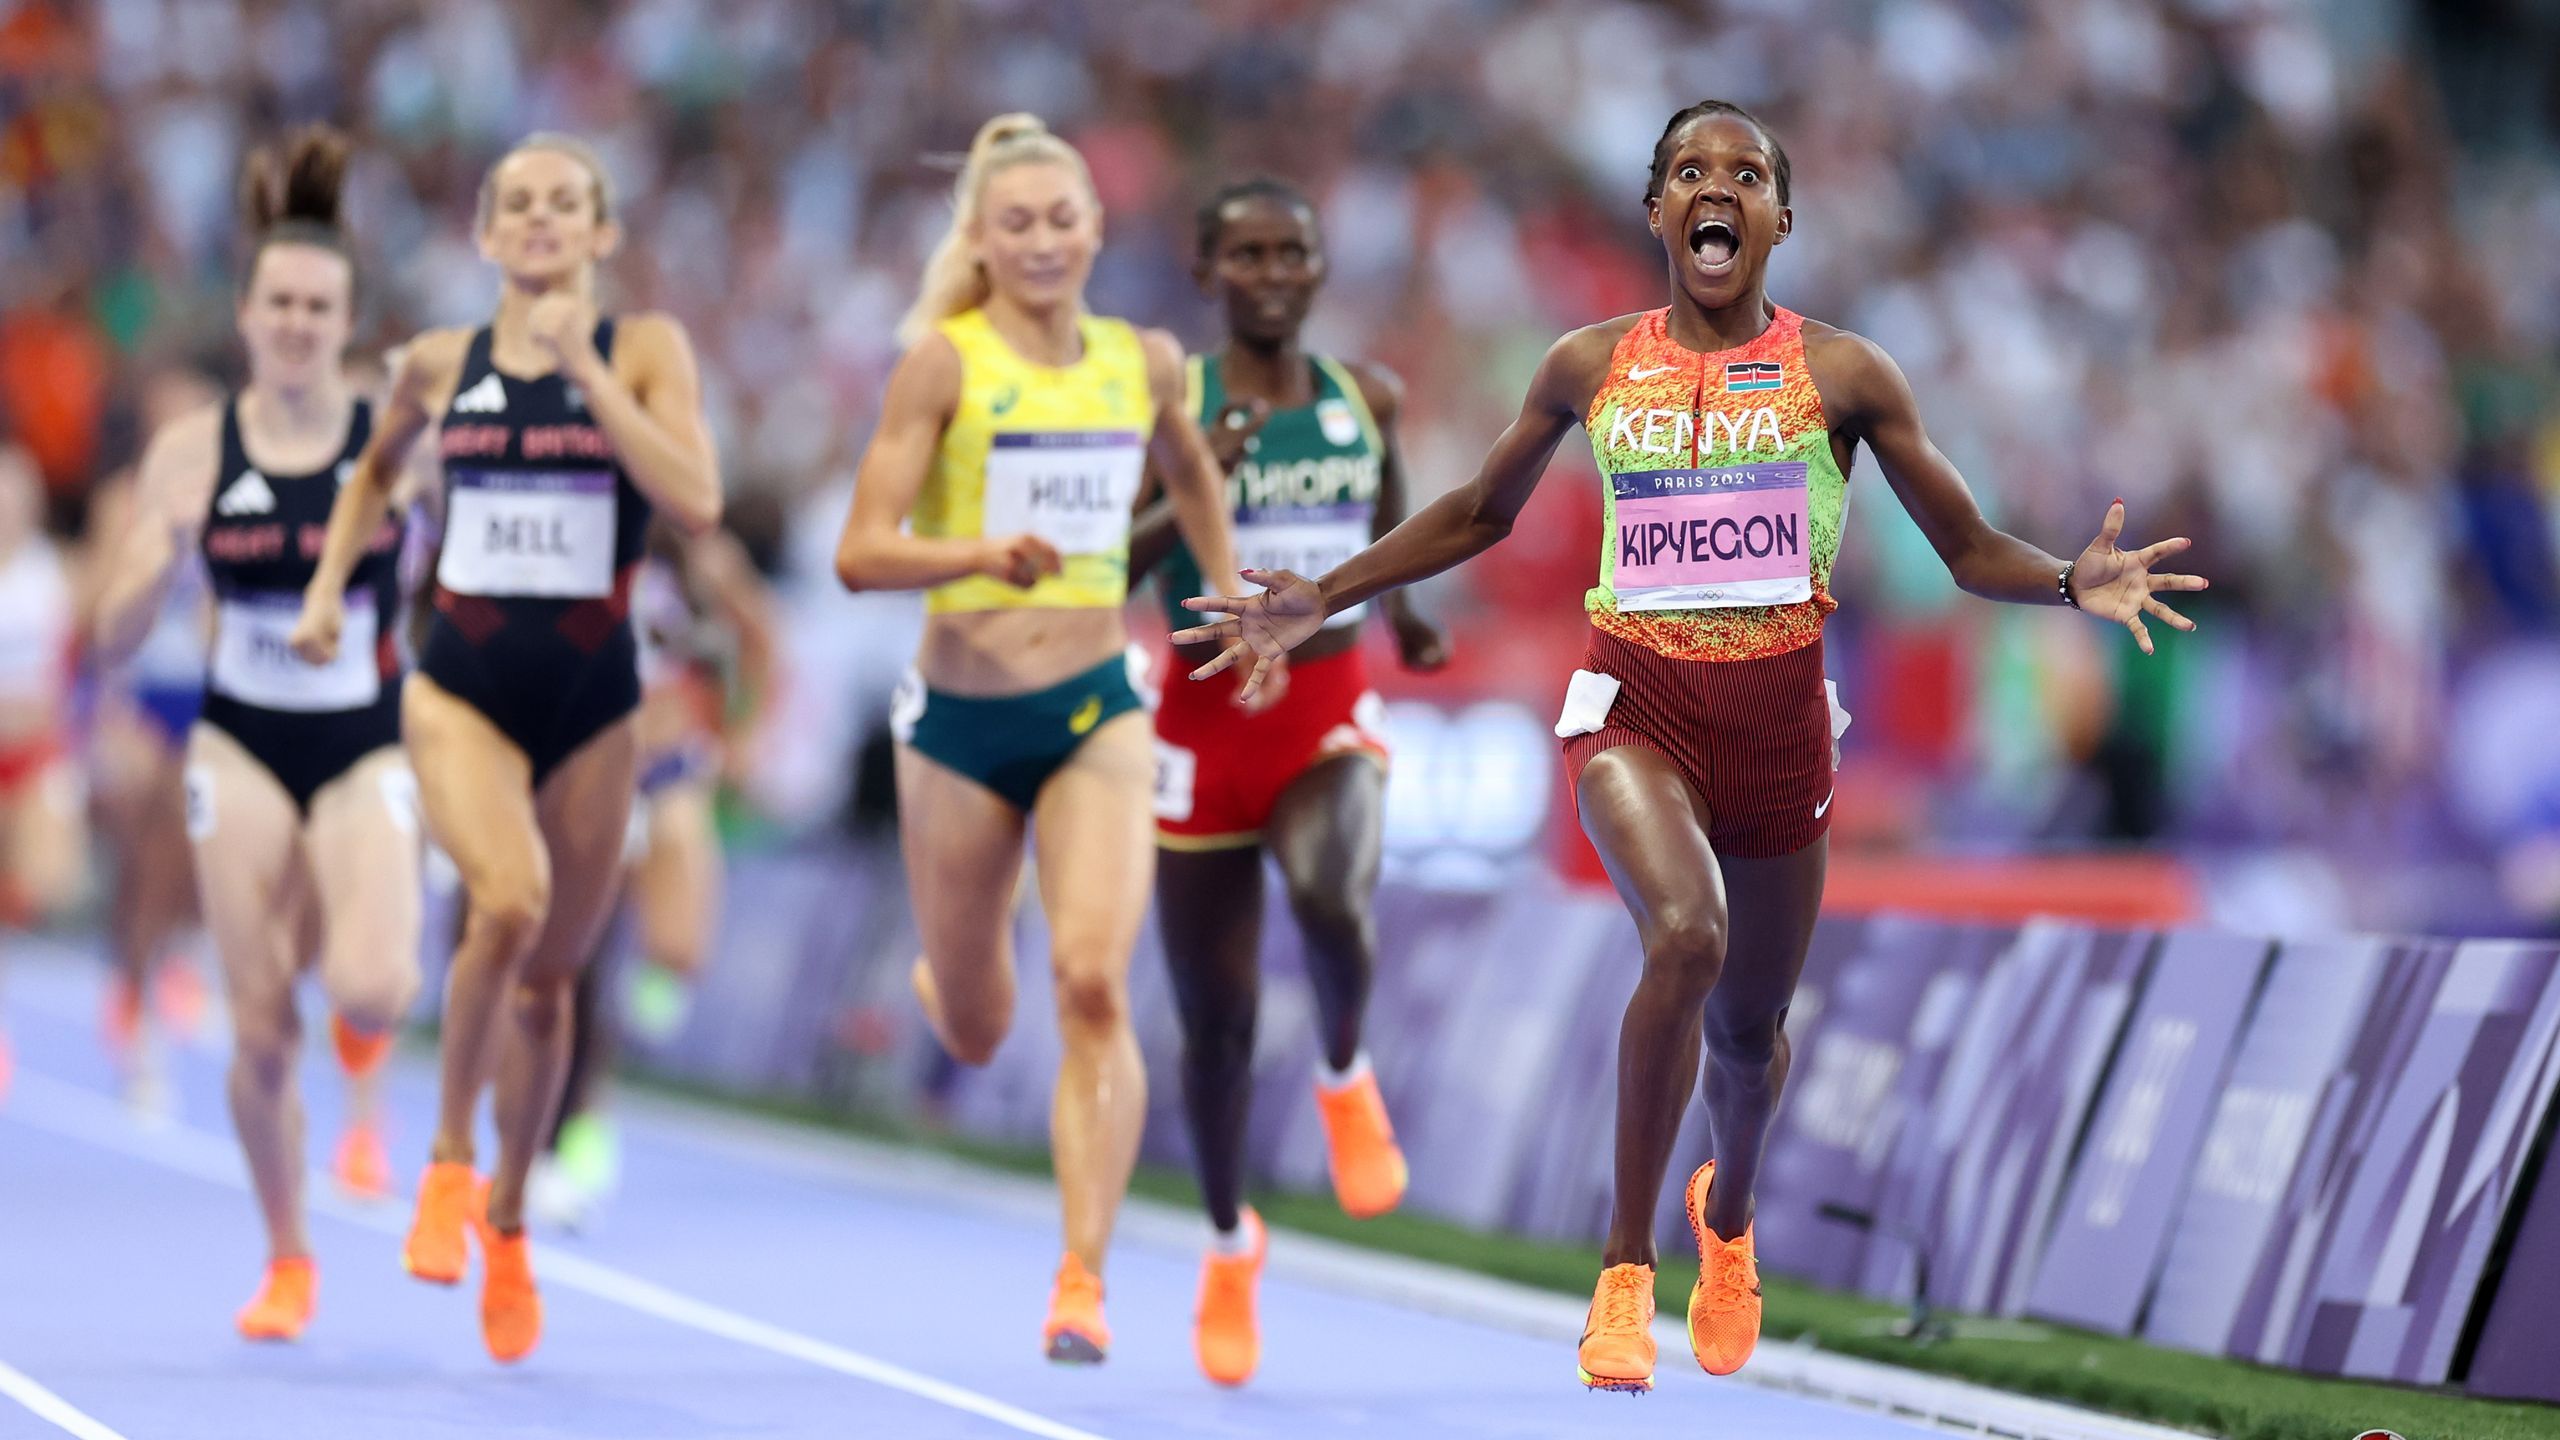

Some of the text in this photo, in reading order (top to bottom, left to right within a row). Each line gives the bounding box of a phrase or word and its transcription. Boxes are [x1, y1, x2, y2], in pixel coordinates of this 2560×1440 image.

[1609, 406, 1785, 455] KENYA
[1030, 474, 1113, 512] HULL
[1654, 471, 1756, 490] PARIS 2024
[485, 513, 572, 555] BELL
[1621, 513, 1798, 567] KIPYEGON
